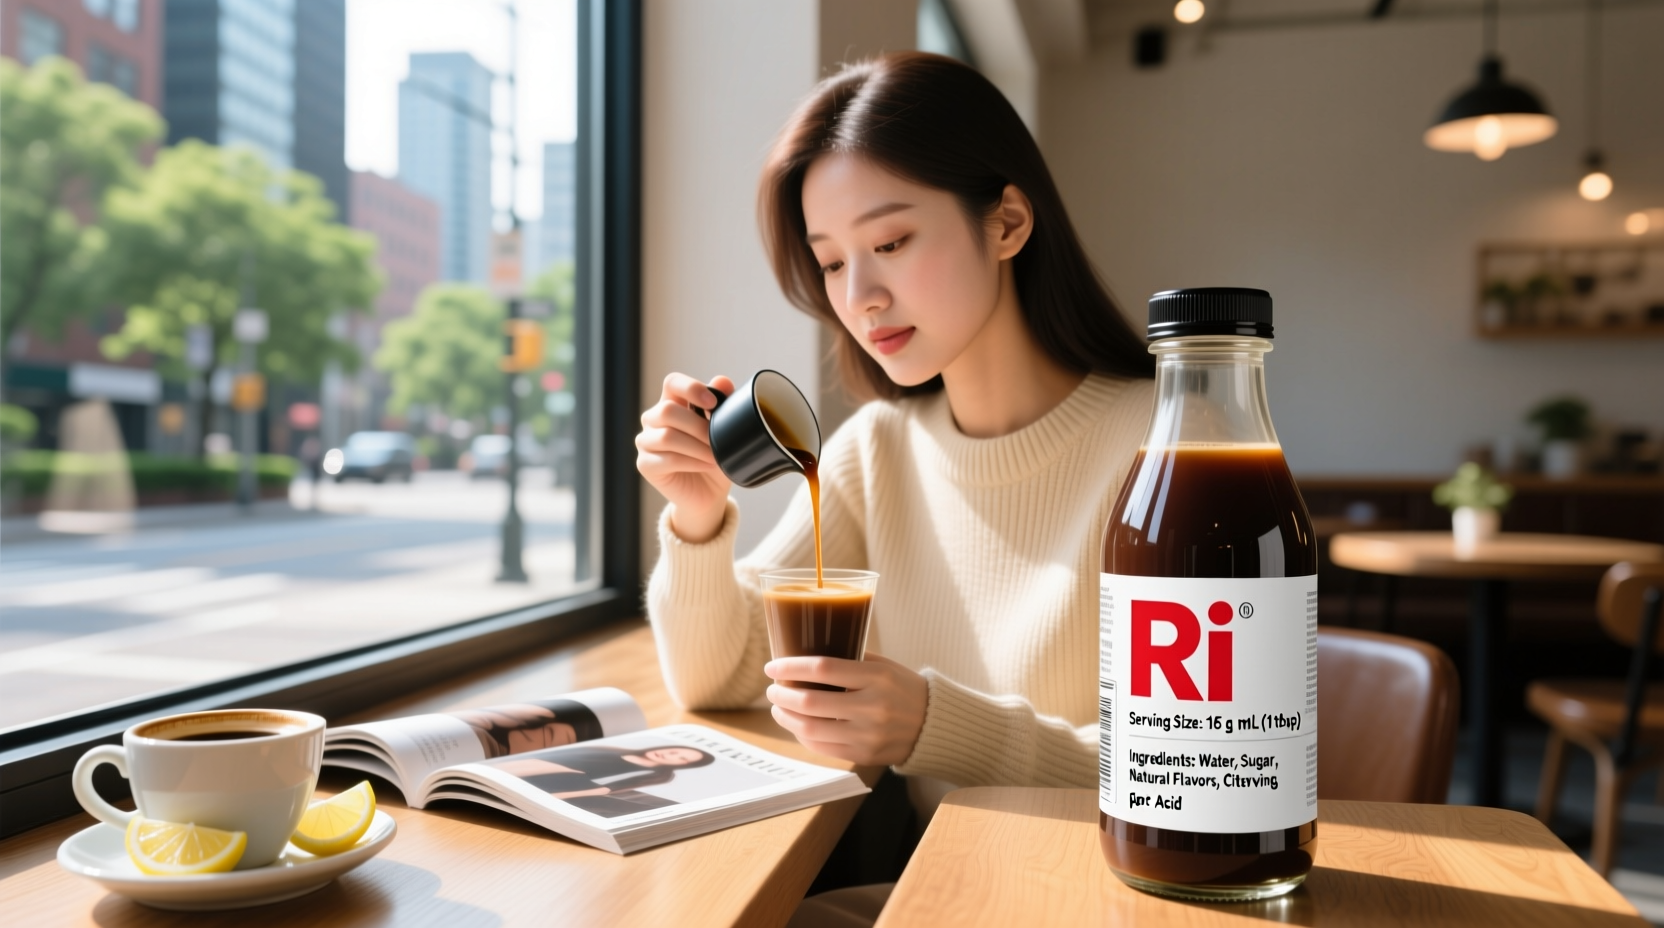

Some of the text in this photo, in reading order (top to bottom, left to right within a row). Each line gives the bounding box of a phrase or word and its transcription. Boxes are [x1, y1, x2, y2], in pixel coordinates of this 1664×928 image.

[1131, 599, 1234, 702] Ri
[1129, 711, 1171, 732] Serving
[1225, 719, 1234, 734] g
[1238, 713, 1260, 731] mL
[1198, 753, 1239, 771] Water,
[1240, 753, 1279, 771] Sugar,
[1129, 768, 1170, 785] Natural
[1172, 771, 1221, 790] Flavors,
[1154, 794, 1183, 811] Acid
